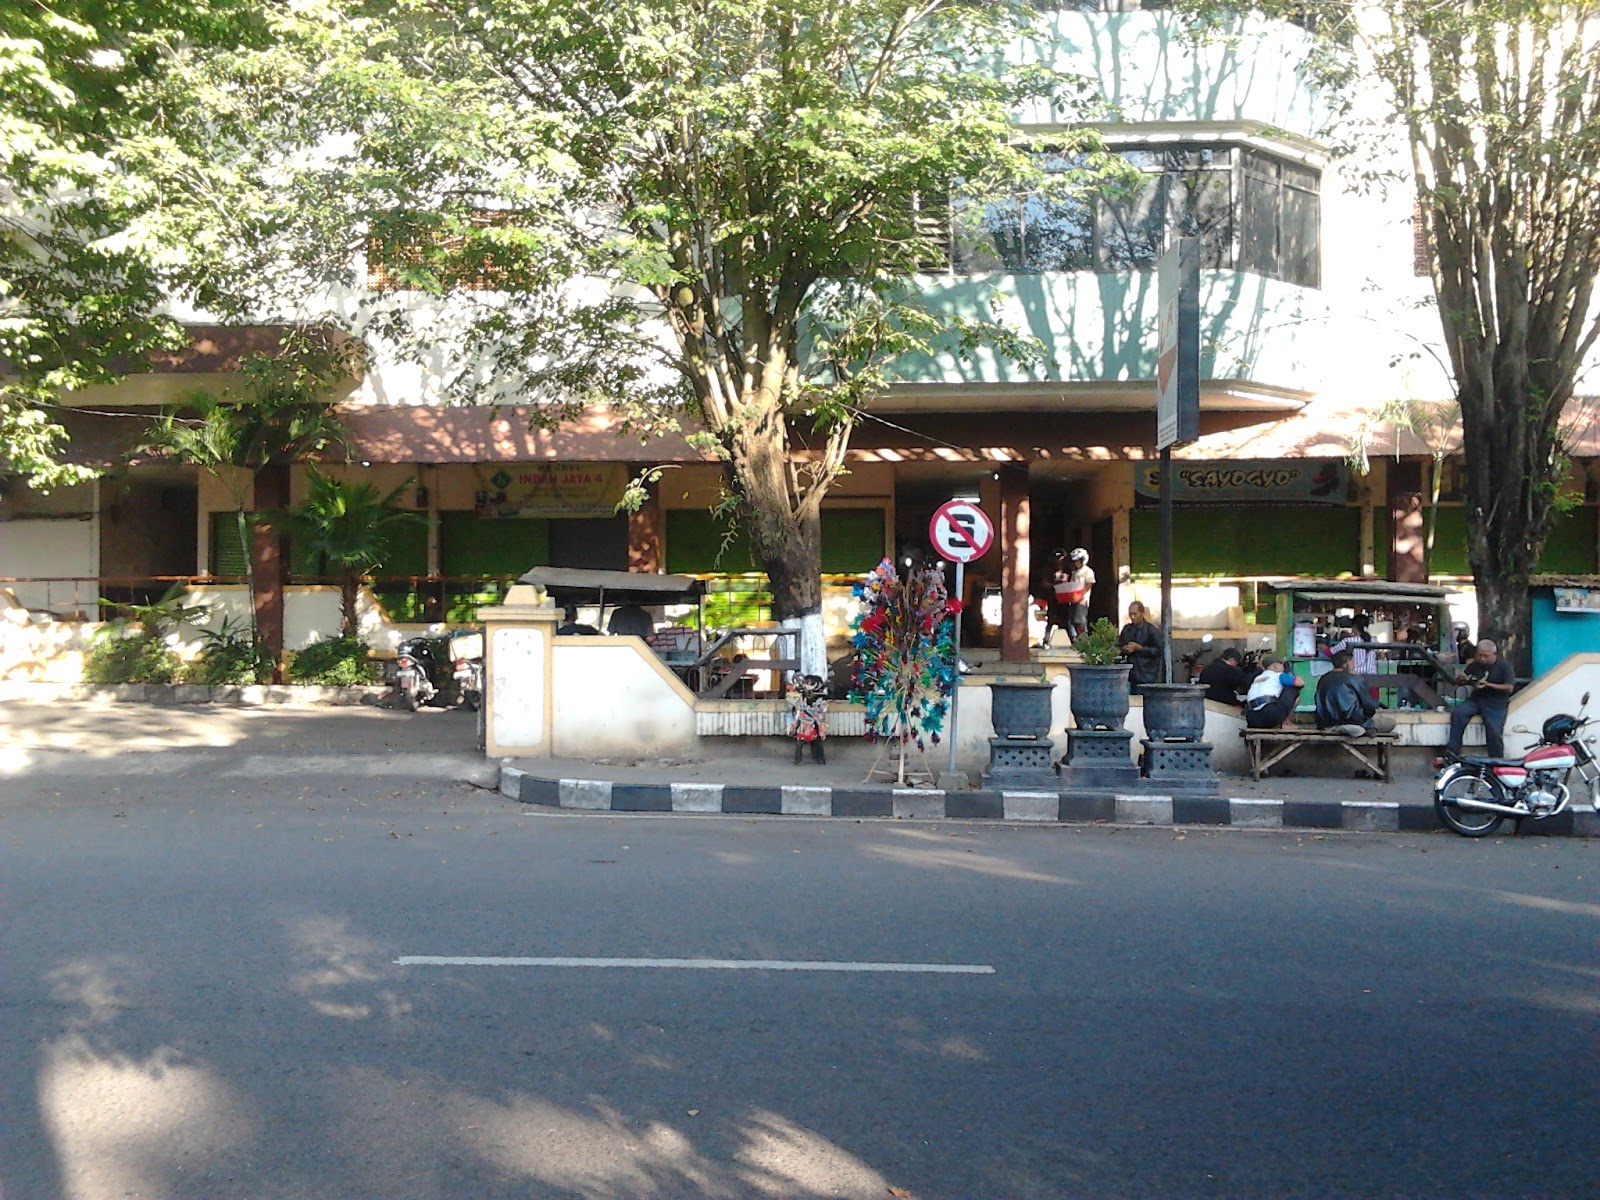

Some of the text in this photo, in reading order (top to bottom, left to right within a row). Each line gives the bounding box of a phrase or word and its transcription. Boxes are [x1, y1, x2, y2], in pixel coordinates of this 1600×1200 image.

[519, 473, 557, 484] INDAH
[561, 473, 591, 484] JAYA
[595, 473, 603, 483] 4
